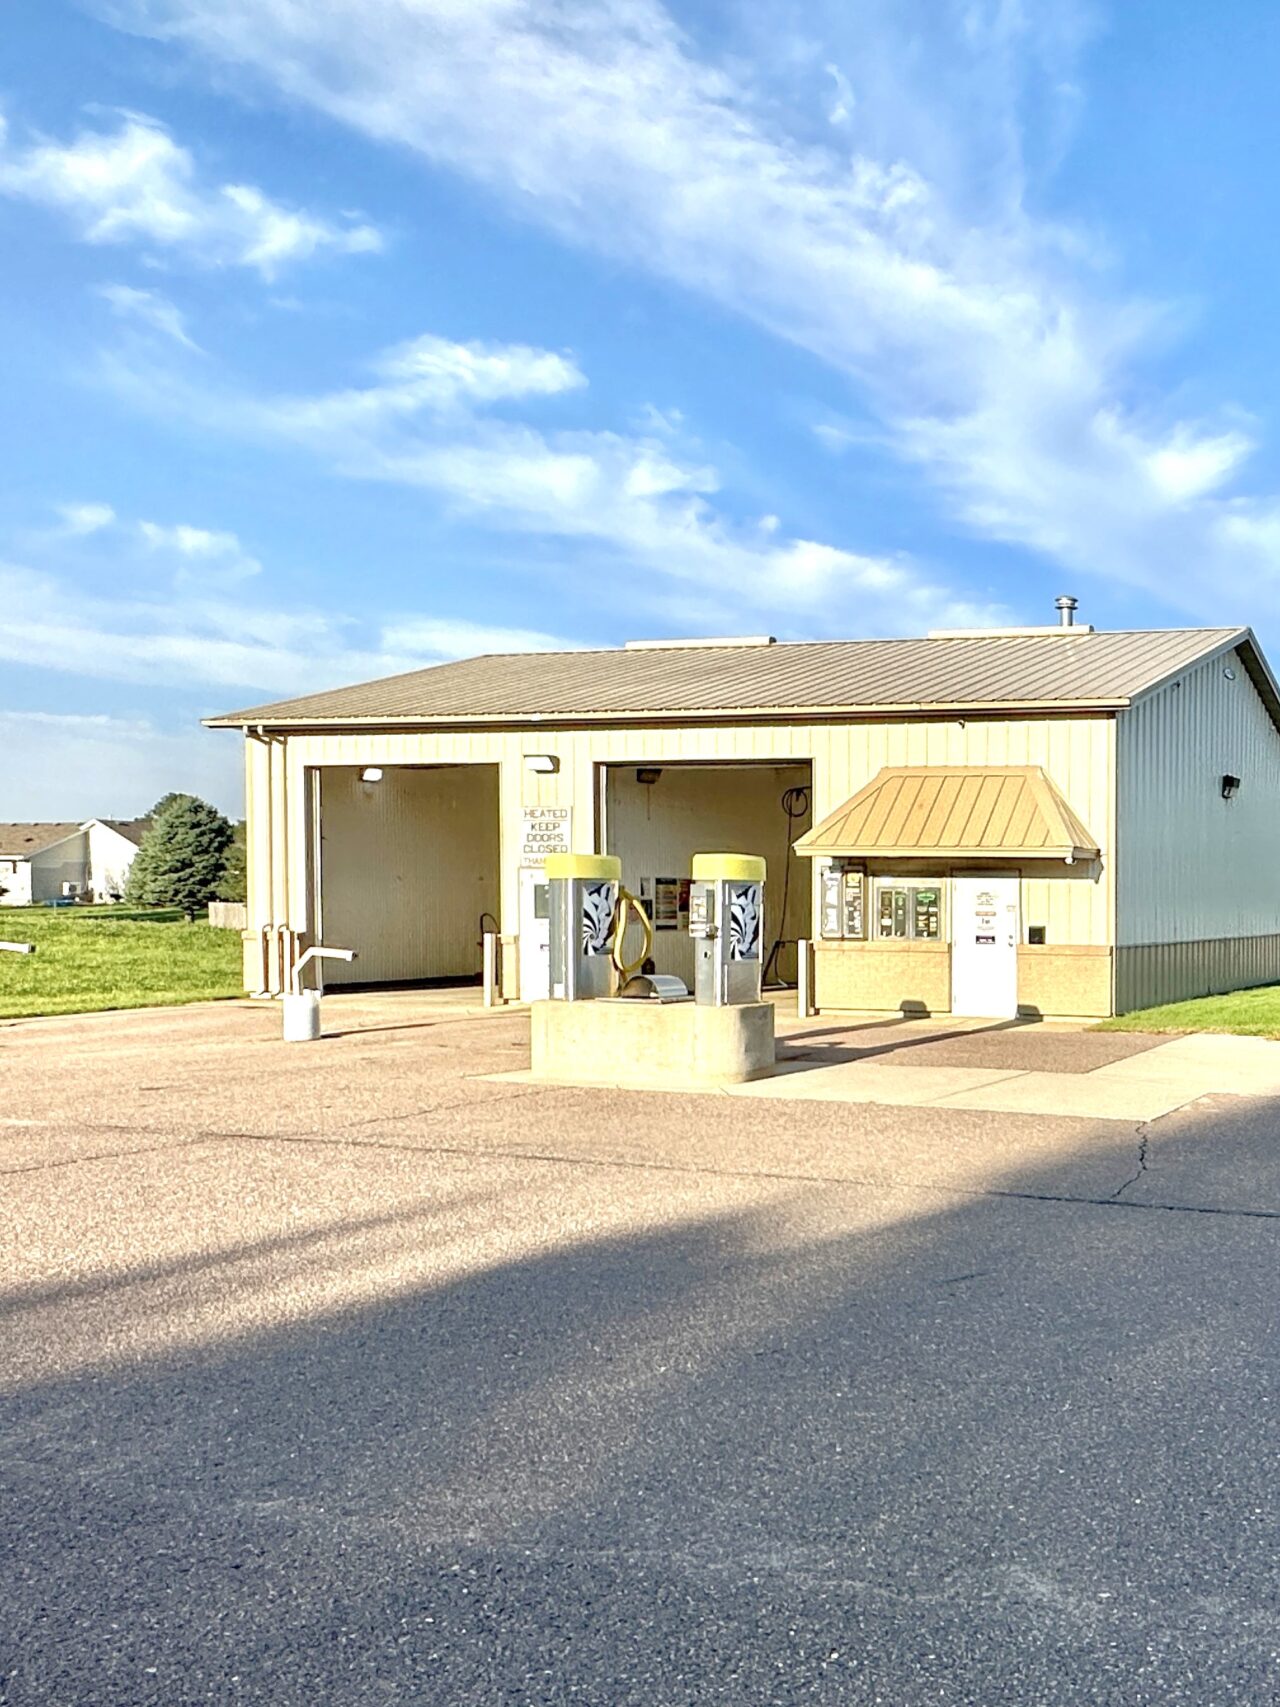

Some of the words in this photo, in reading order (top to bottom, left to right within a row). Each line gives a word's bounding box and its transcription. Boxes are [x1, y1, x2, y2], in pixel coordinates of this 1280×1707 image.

[523, 809, 568, 818] HEATED
[530, 822, 561, 831] KEEP
[526, 833, 564, 842] DOORS
[523, 844, 568, 854] CLOSED
